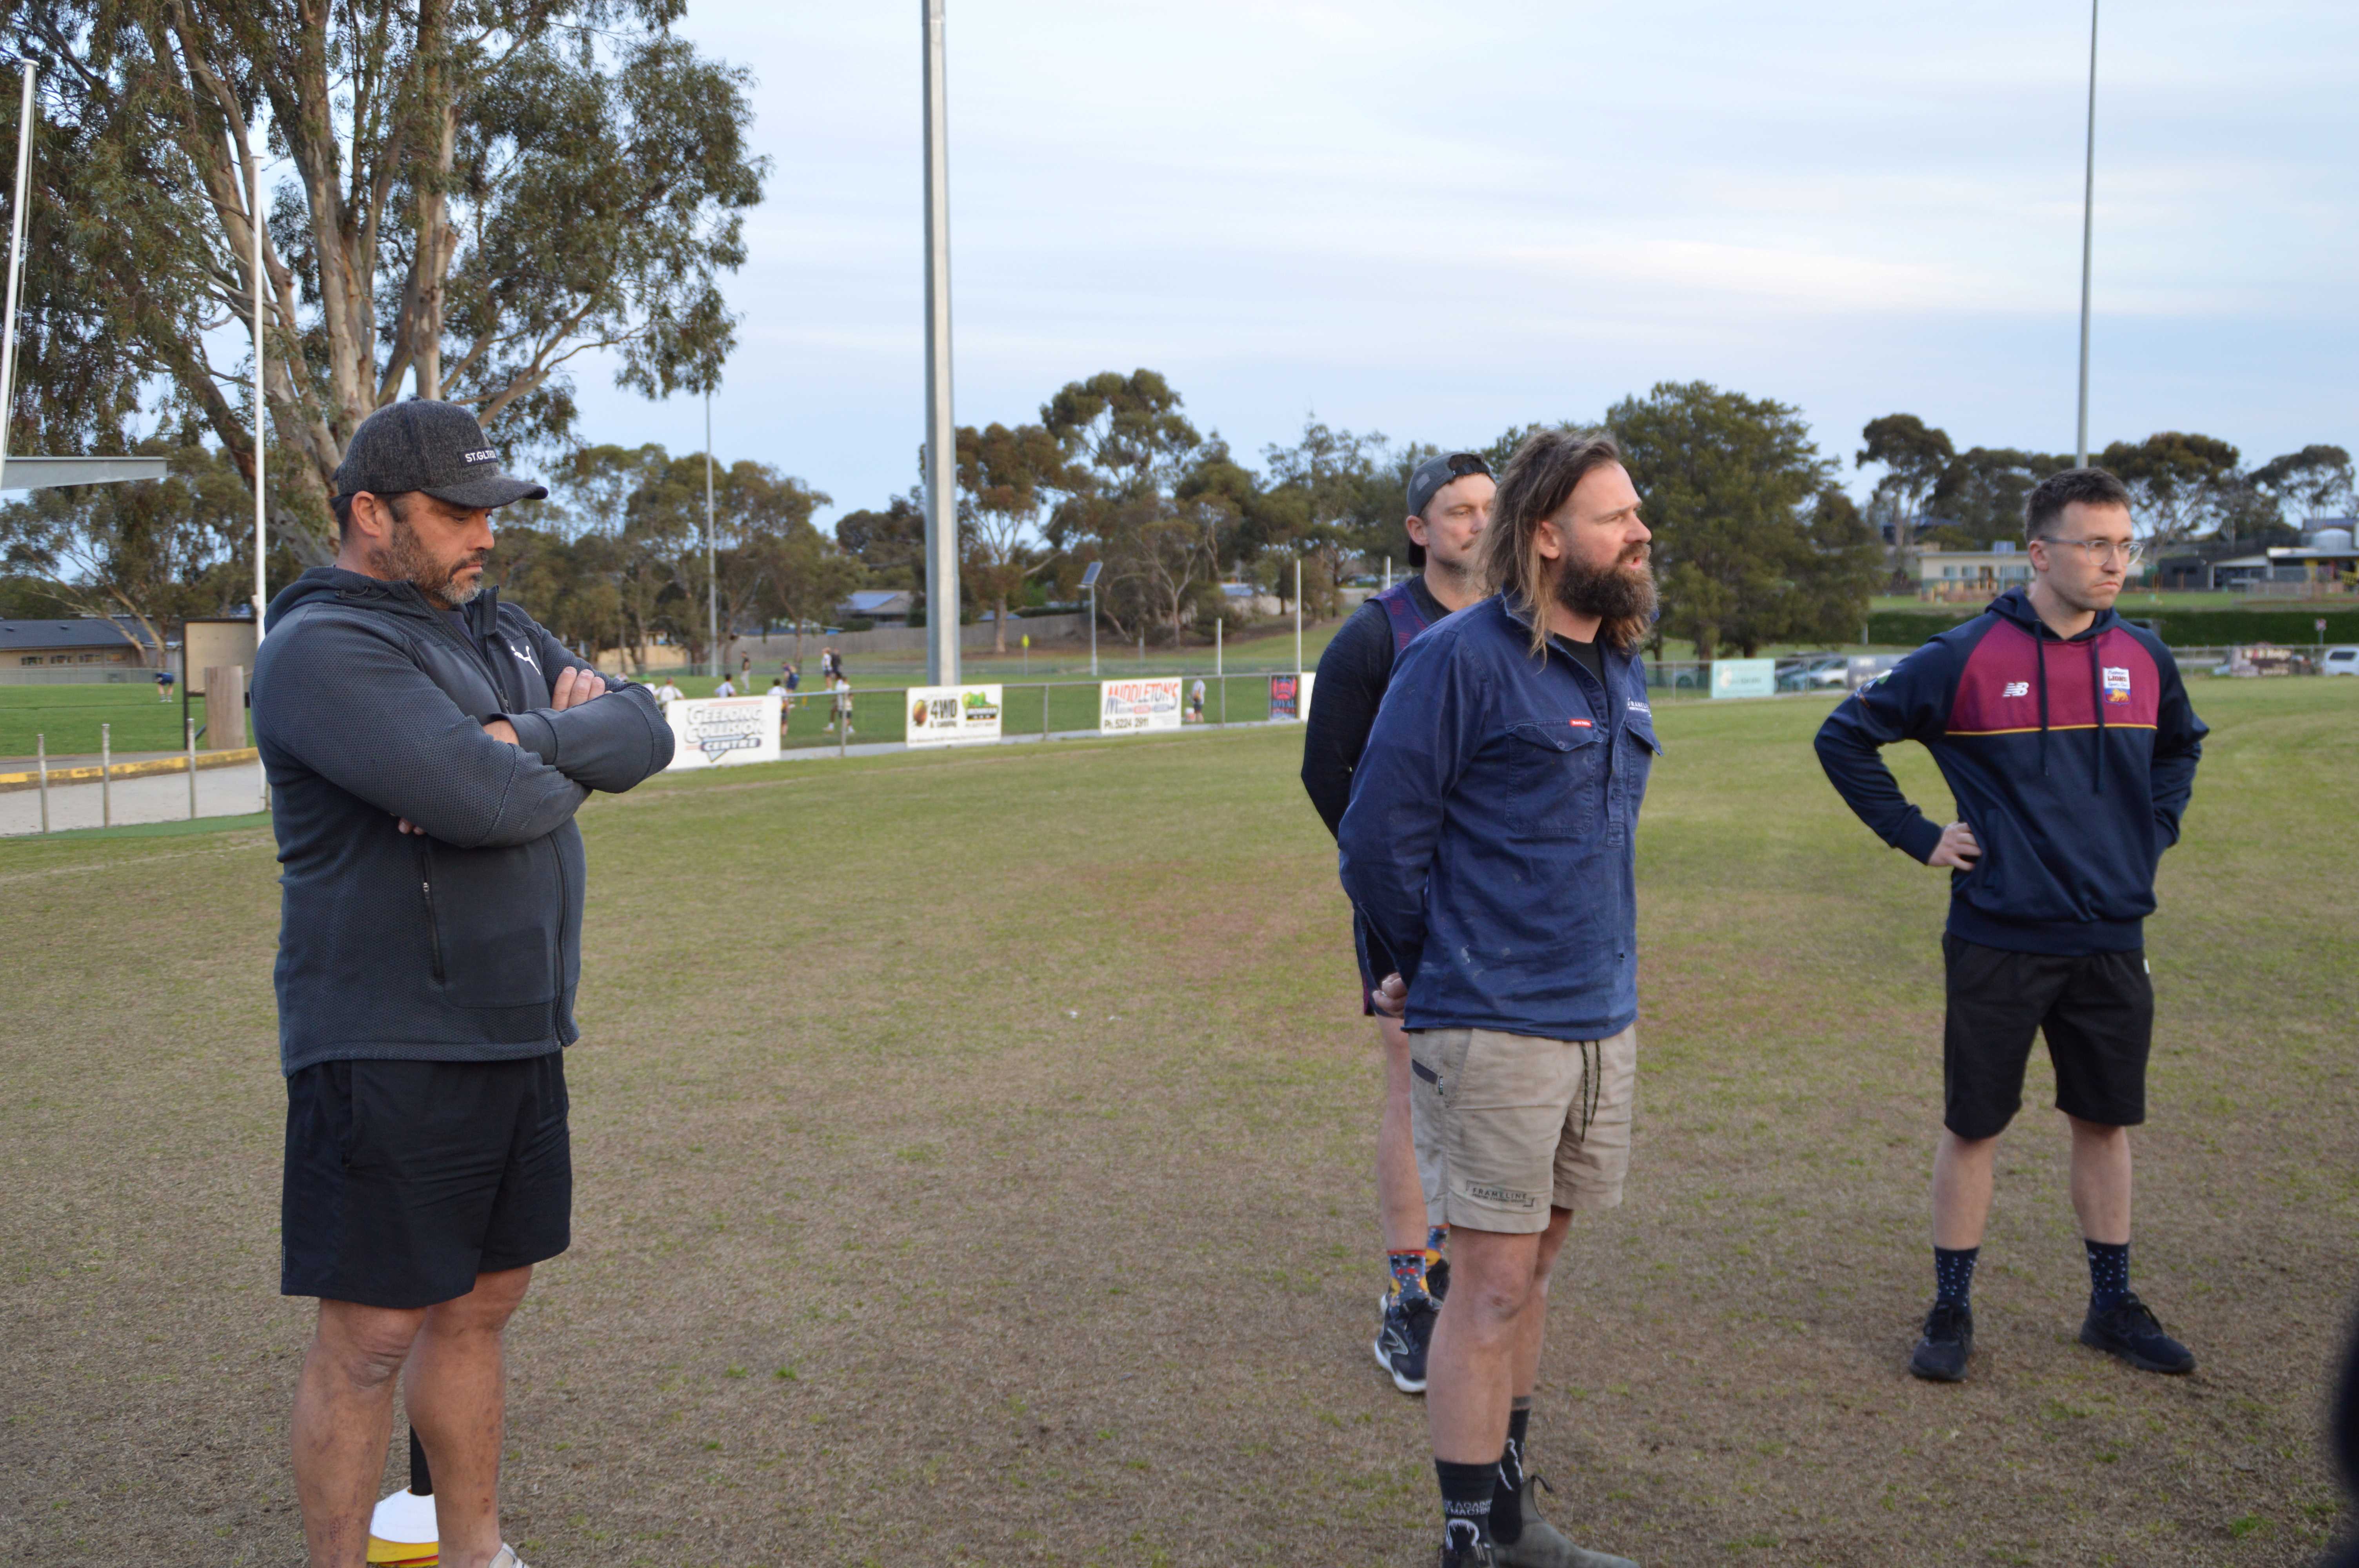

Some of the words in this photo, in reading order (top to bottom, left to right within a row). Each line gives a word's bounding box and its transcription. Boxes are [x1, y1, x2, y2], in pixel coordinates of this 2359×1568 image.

[687, 705, 762, 725] GEELONG
[930, 699, 957, 719] 4WD
[684, 721, 765, 743] COLLISION
[1472, 1187, 1527, 1200] FRAMELINE
